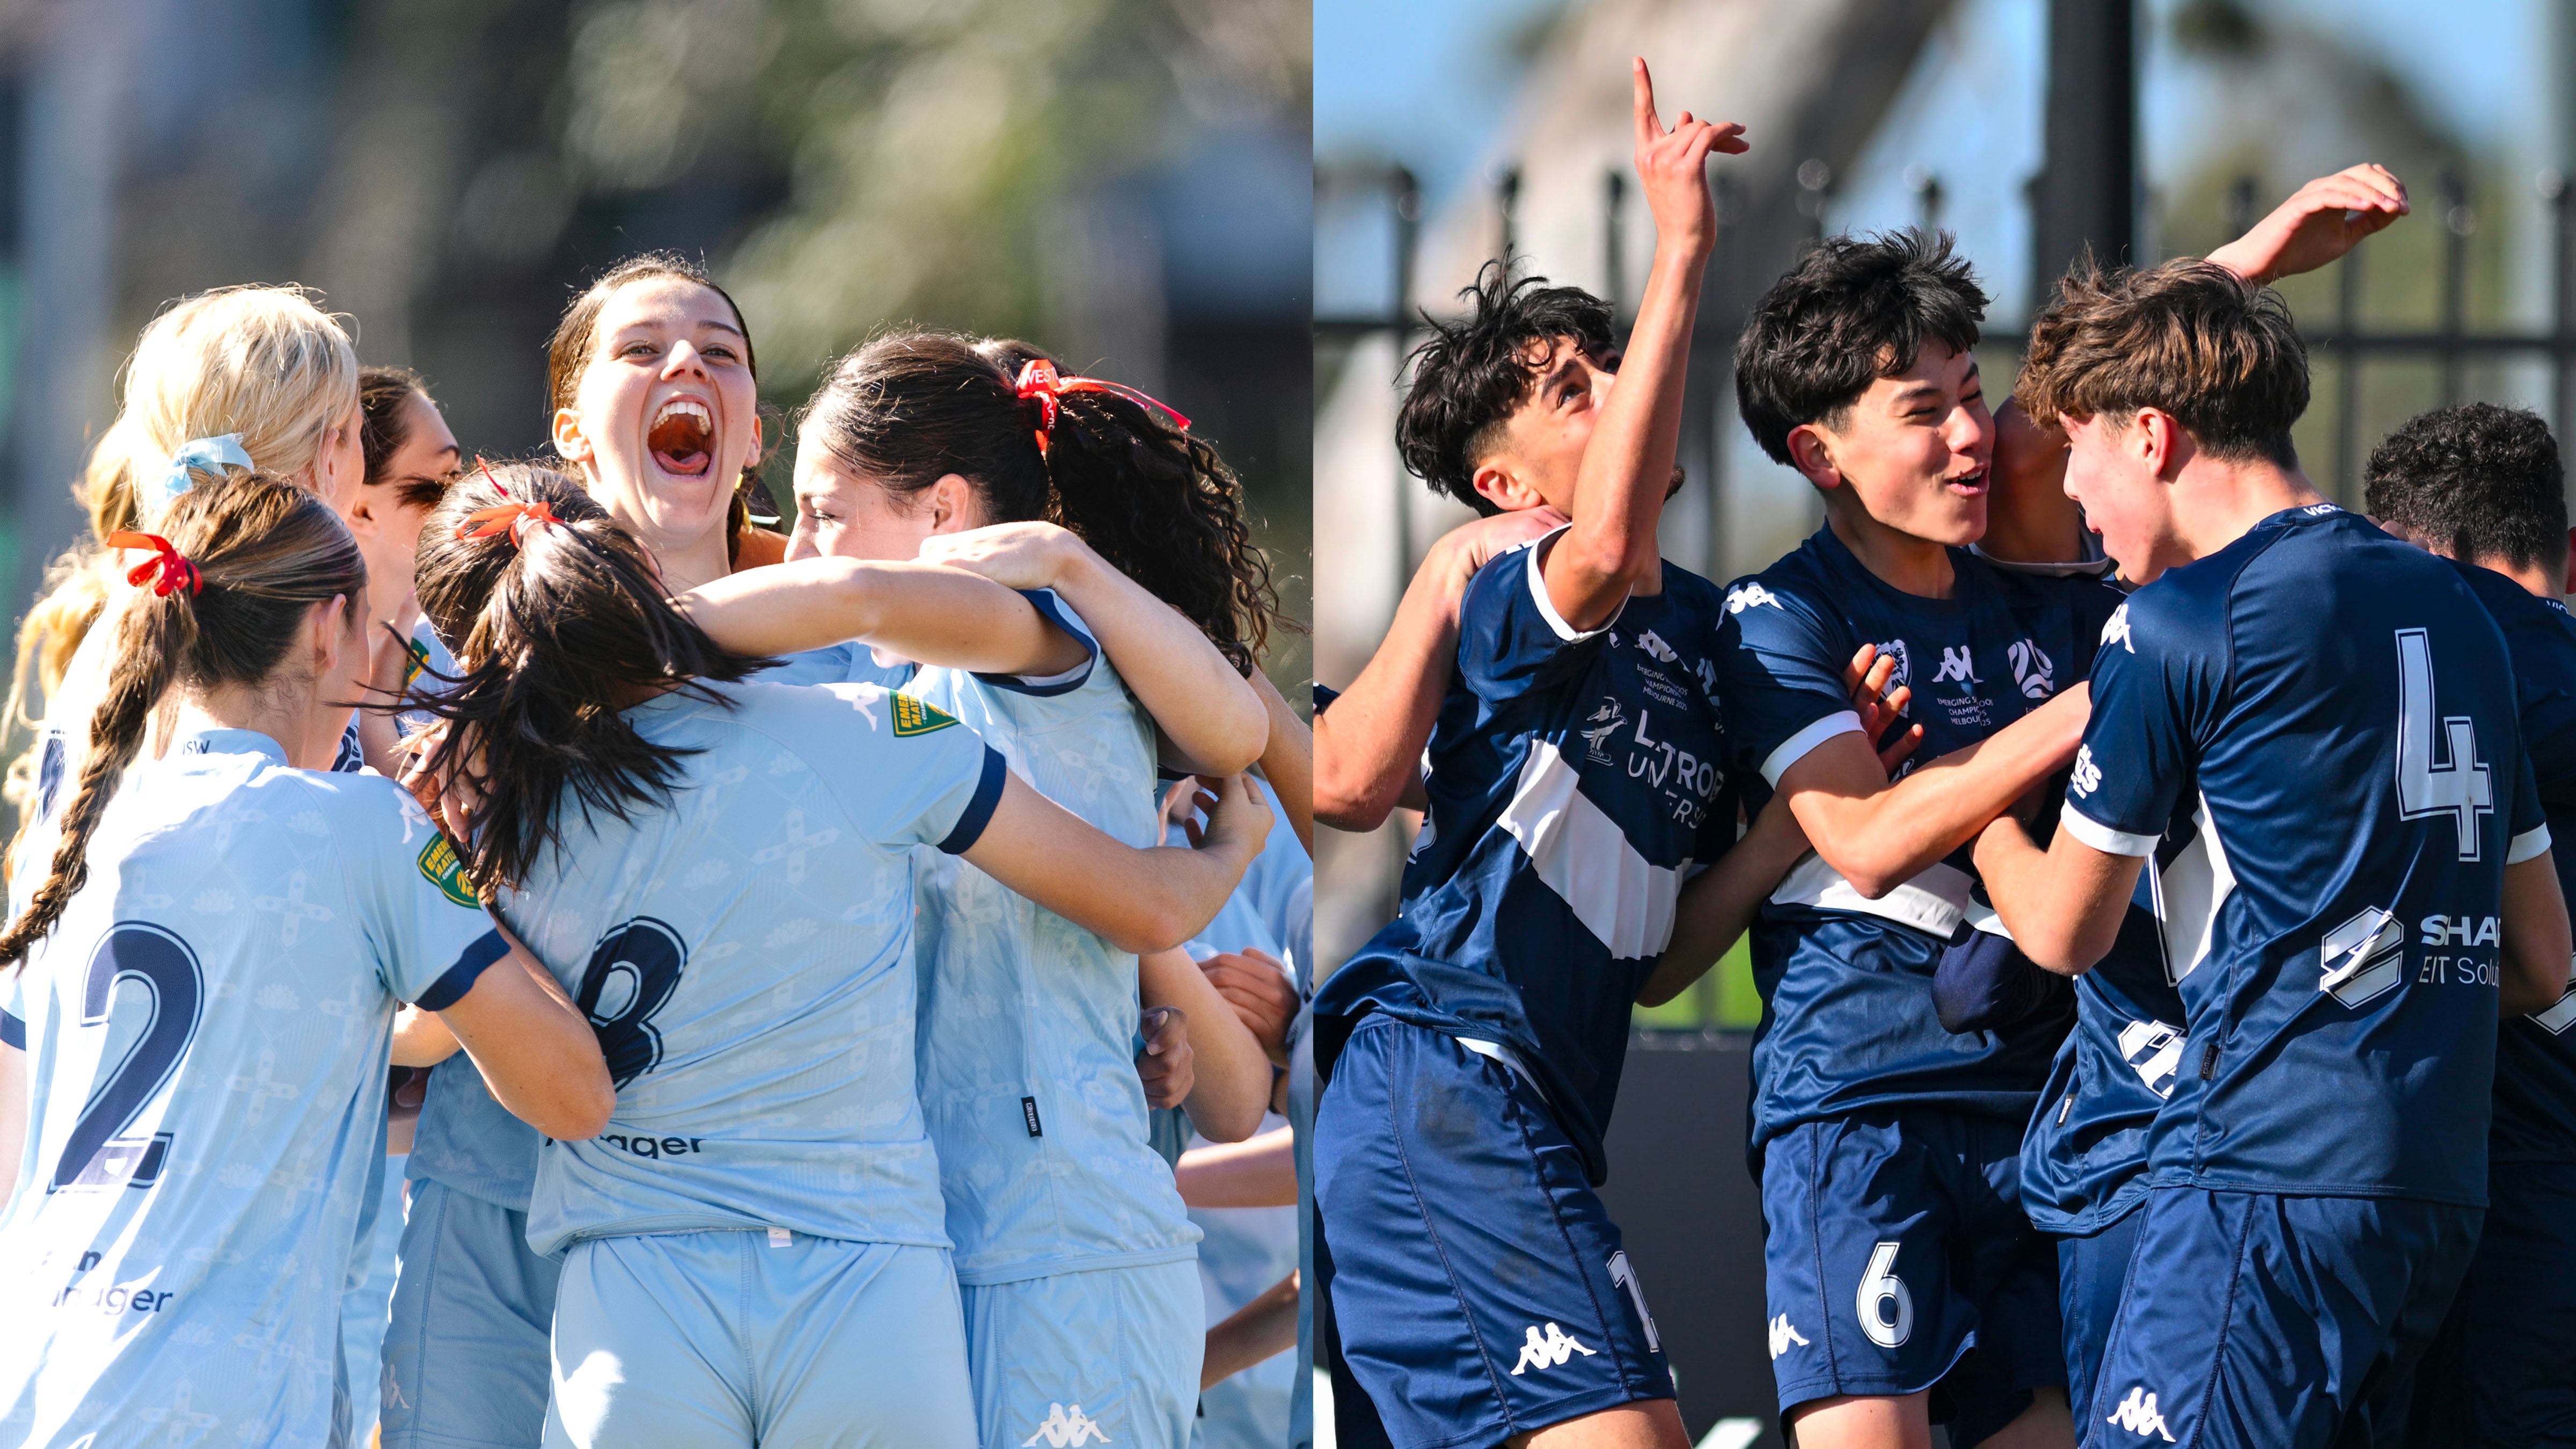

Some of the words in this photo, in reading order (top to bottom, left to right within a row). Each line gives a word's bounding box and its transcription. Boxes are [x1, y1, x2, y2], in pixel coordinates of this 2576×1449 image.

[2395, 626, 2494, 862] 4
[2419, 956, 2450, 984] EIT
[2420, 914, 2501, 949] SHA
[45, 920, 205, 1195] 2
[1856, 1241, 1914, 1348] 6
